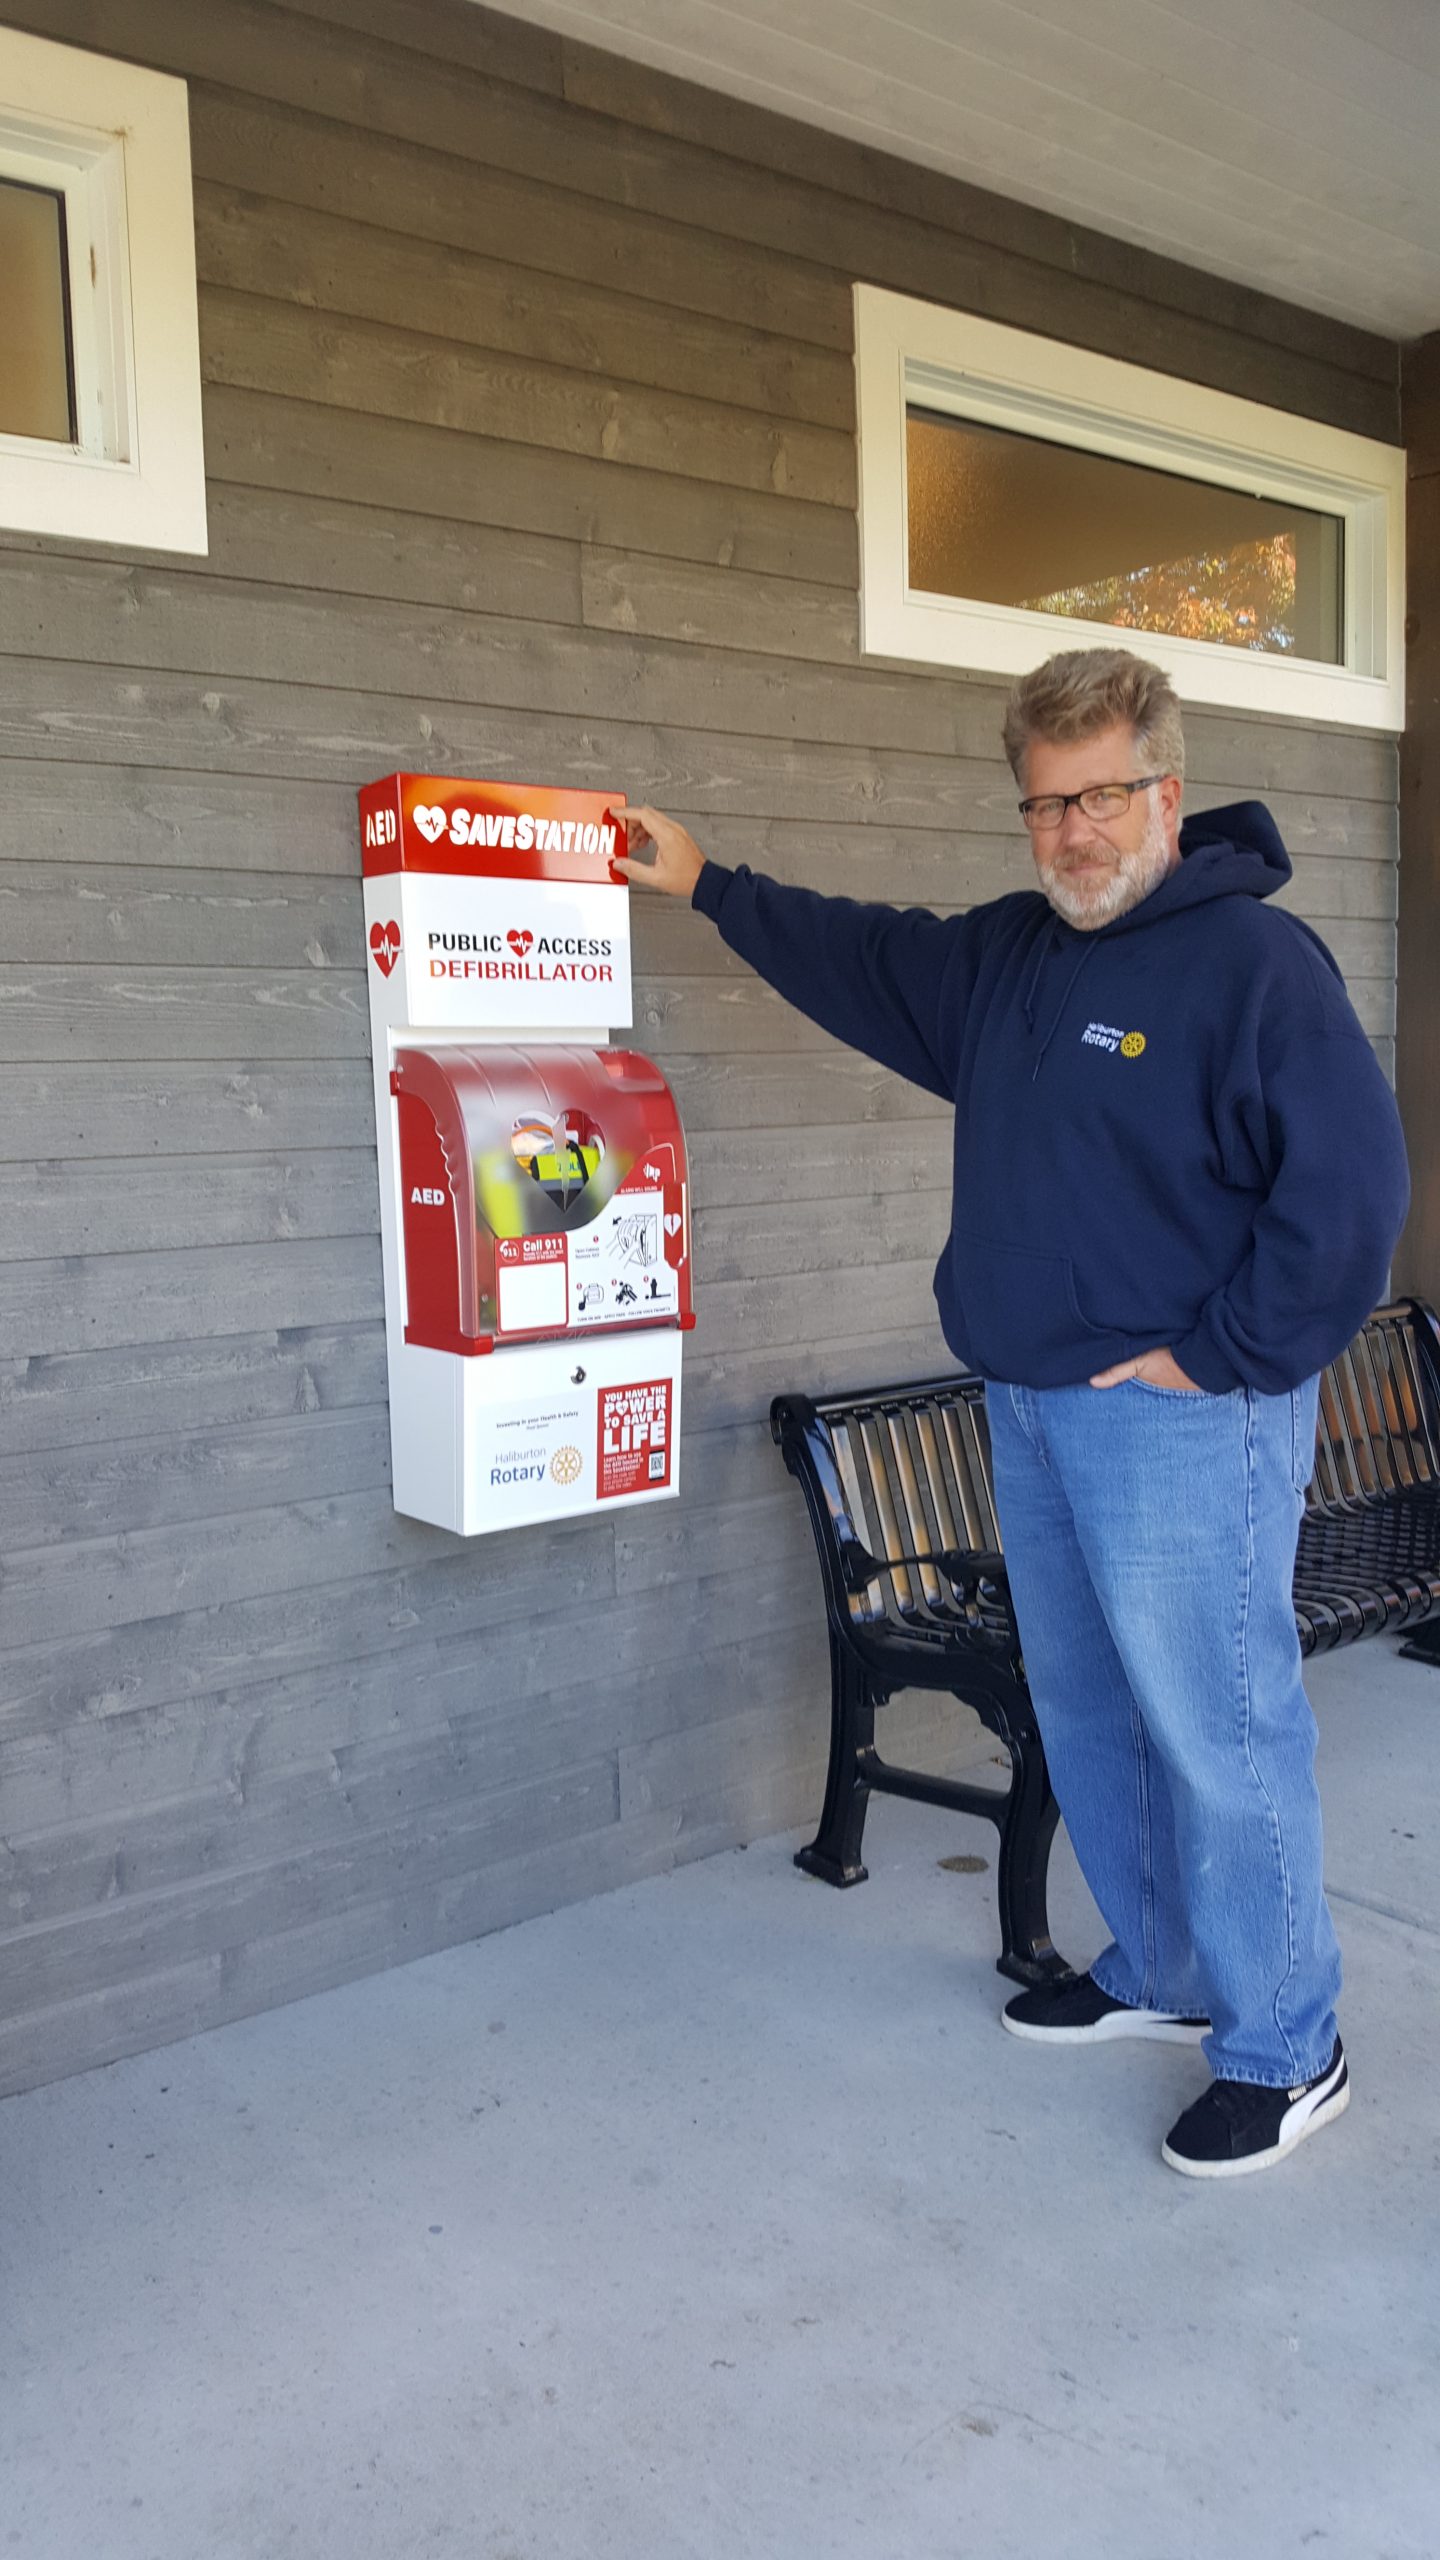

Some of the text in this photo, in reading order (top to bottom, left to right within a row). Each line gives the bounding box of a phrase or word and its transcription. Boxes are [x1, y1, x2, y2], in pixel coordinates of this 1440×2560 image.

[366, 808, 396, 848] AED
[428, 932, 612, 956] PUBLIC ACCESS
[430, 960, 613, 982] DEFIBRILLATOR
[1081, 1029, 1120, 1052] Rotary
[411, 1187, 445, 1206] AED
[503, 1247, 518, 1258] 911
[523, 1239, 543, 1252] Call
[544, 1238, 564, 1250] 911
[605, 1385, 667, 1403] YOU HAVE THE
[604, 1409, 666, 1429] TO SAVE A
[604, 1420, 666, 1455] LIFE
[495, 1447, 546, 1464] Haliburton
[490, 1463, 545, 1486] Rotary
